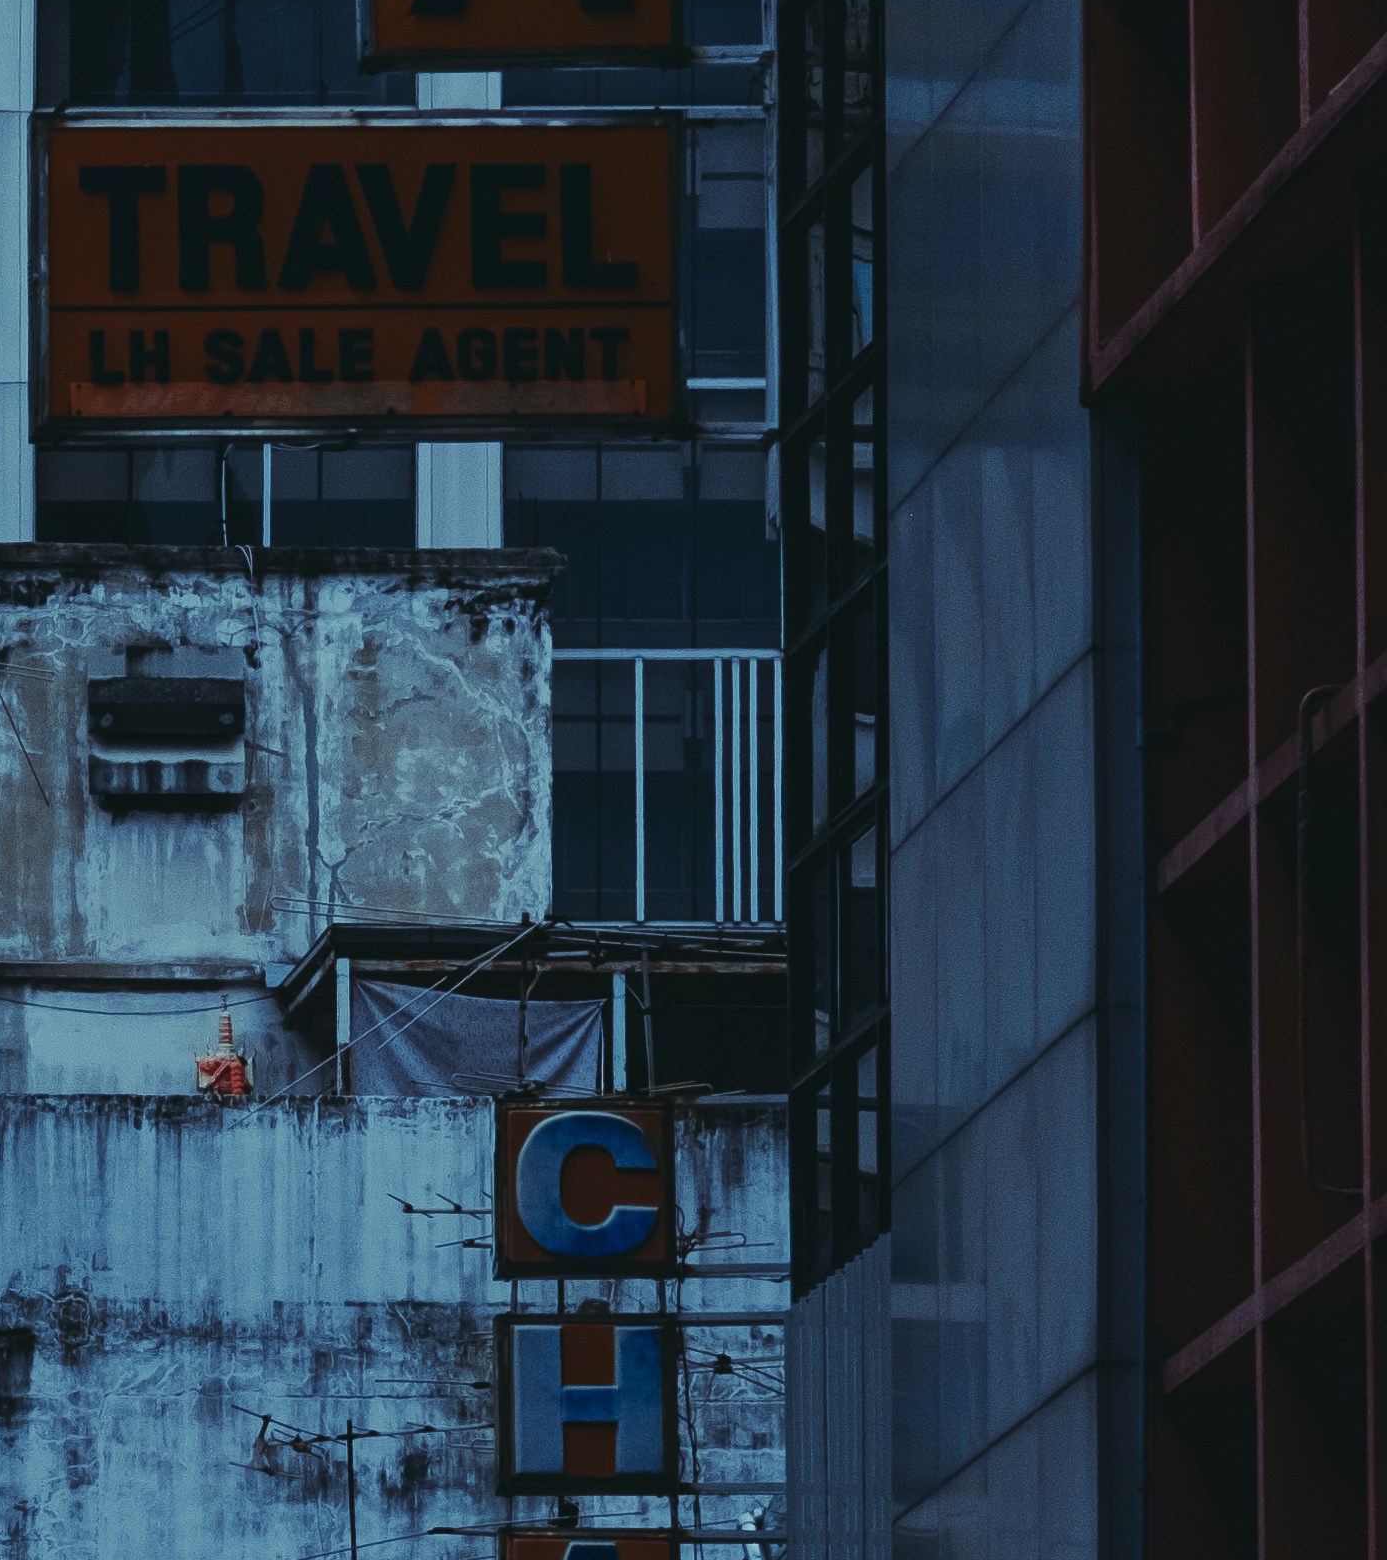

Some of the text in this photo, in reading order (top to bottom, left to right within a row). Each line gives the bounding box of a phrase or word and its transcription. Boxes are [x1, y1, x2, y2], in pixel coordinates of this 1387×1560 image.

[79, 162, 640, 295] TRAVEL
[89, 327, 630, 386] LH SALE AGENT
